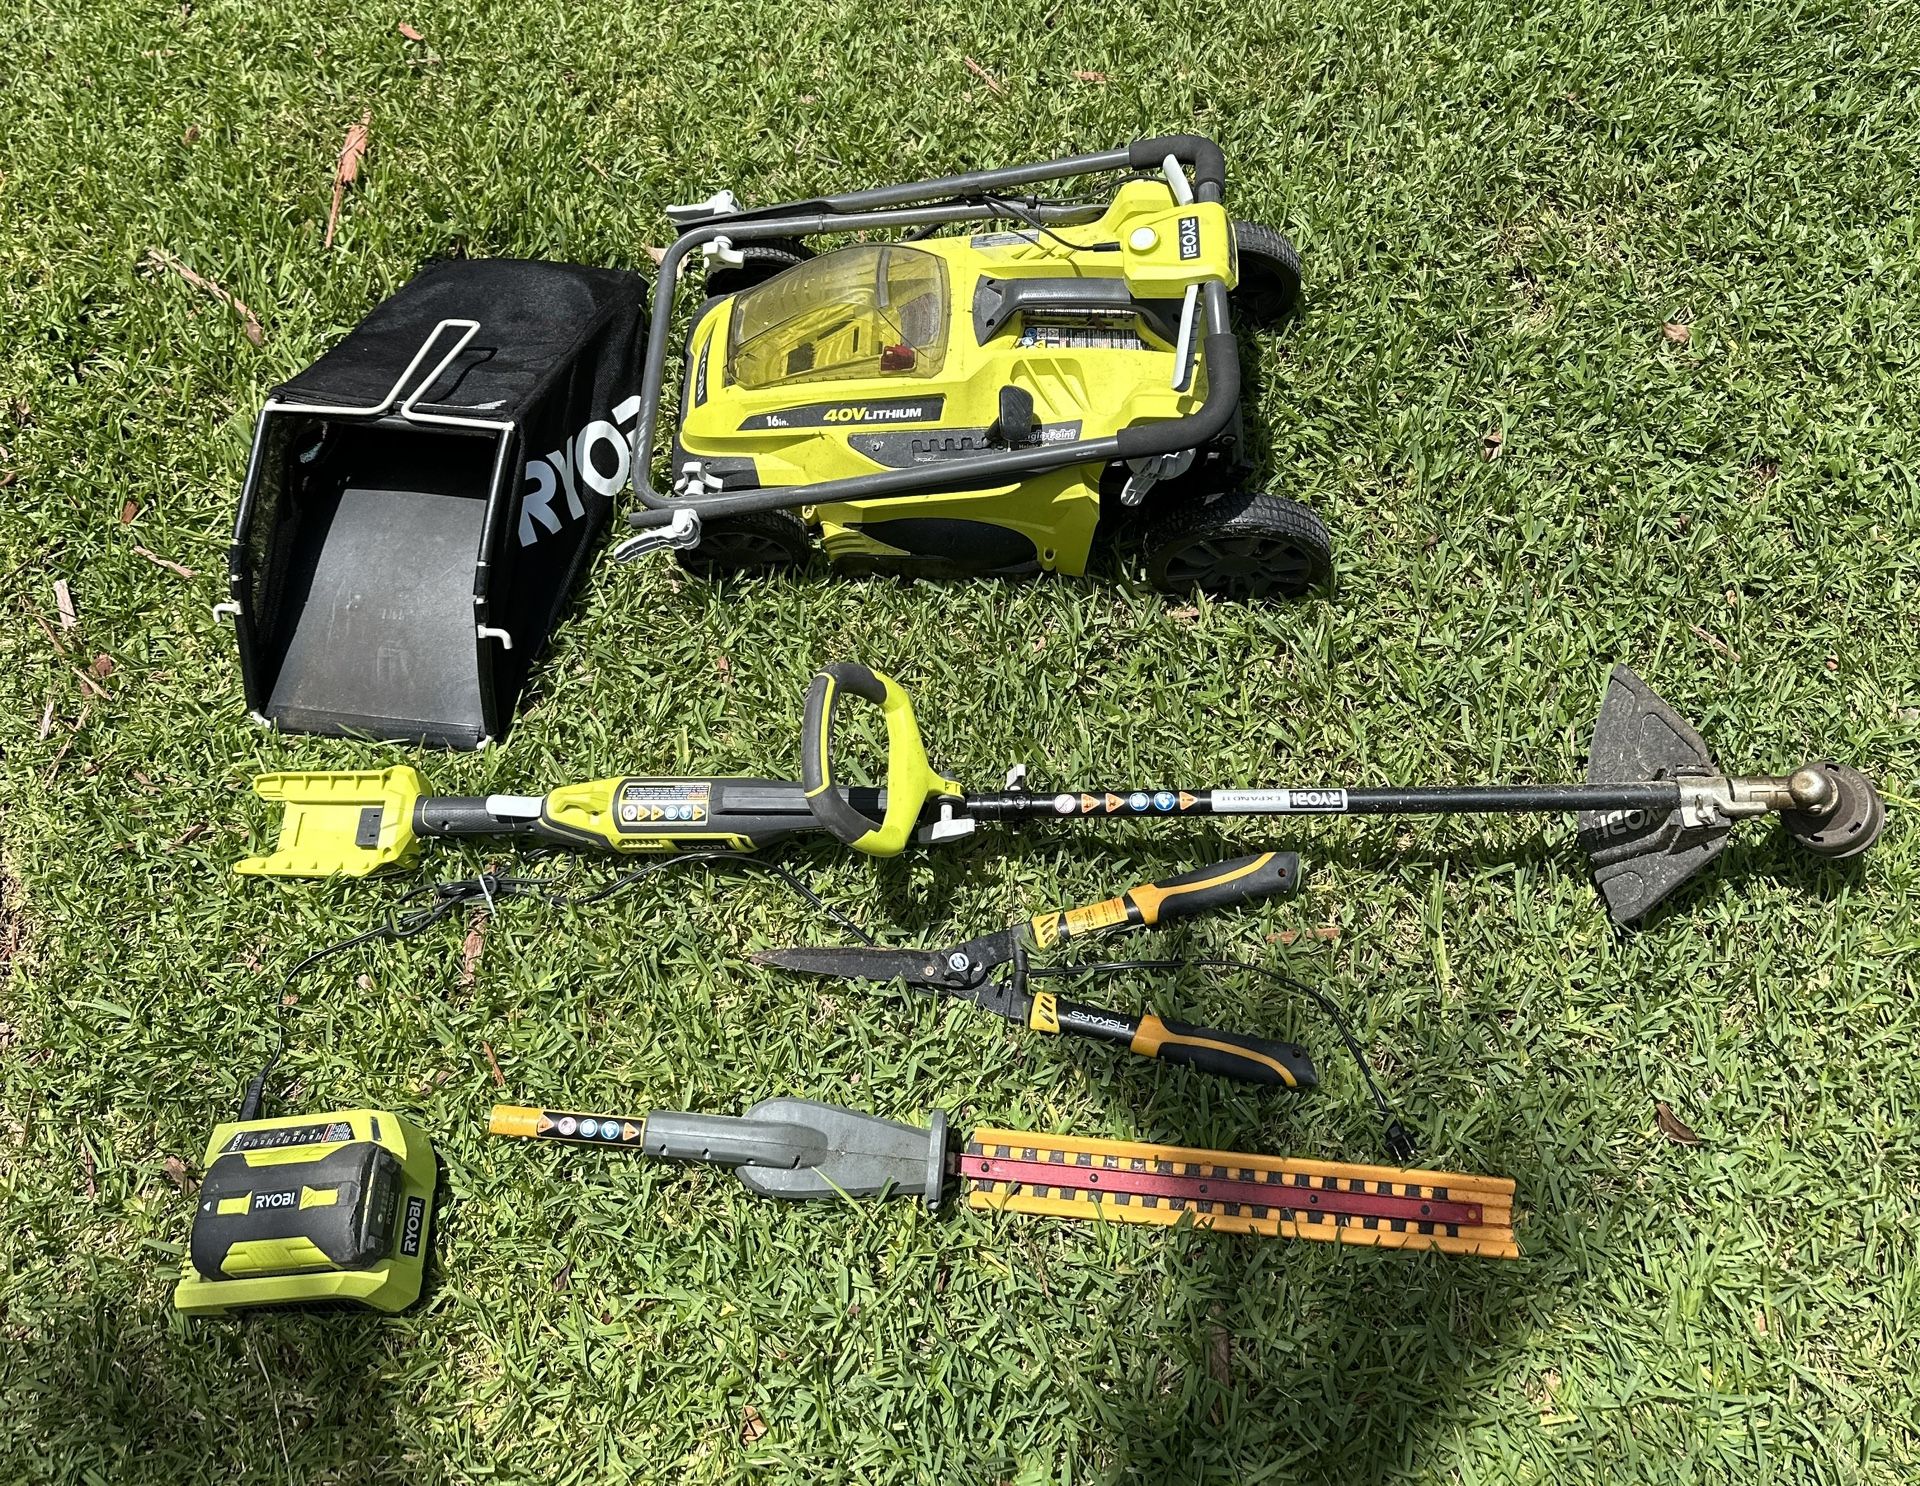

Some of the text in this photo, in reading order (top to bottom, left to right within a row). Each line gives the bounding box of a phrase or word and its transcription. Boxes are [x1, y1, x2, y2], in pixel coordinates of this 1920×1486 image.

[1181, 218, 1197, 258] RYOBI
[766, 415, 789, 428] 16in.
[864, 408, 922, 421] LITHIUM
[518, 395, 642, 548] RYO
[1291, 792, 1341, 807] RYOBI
[1071, 1010, 1130, 1031] FISKARS
[255, 1192, 296, 1209] RYOBI
[403, 1200, 422, 1252] RYOBI
